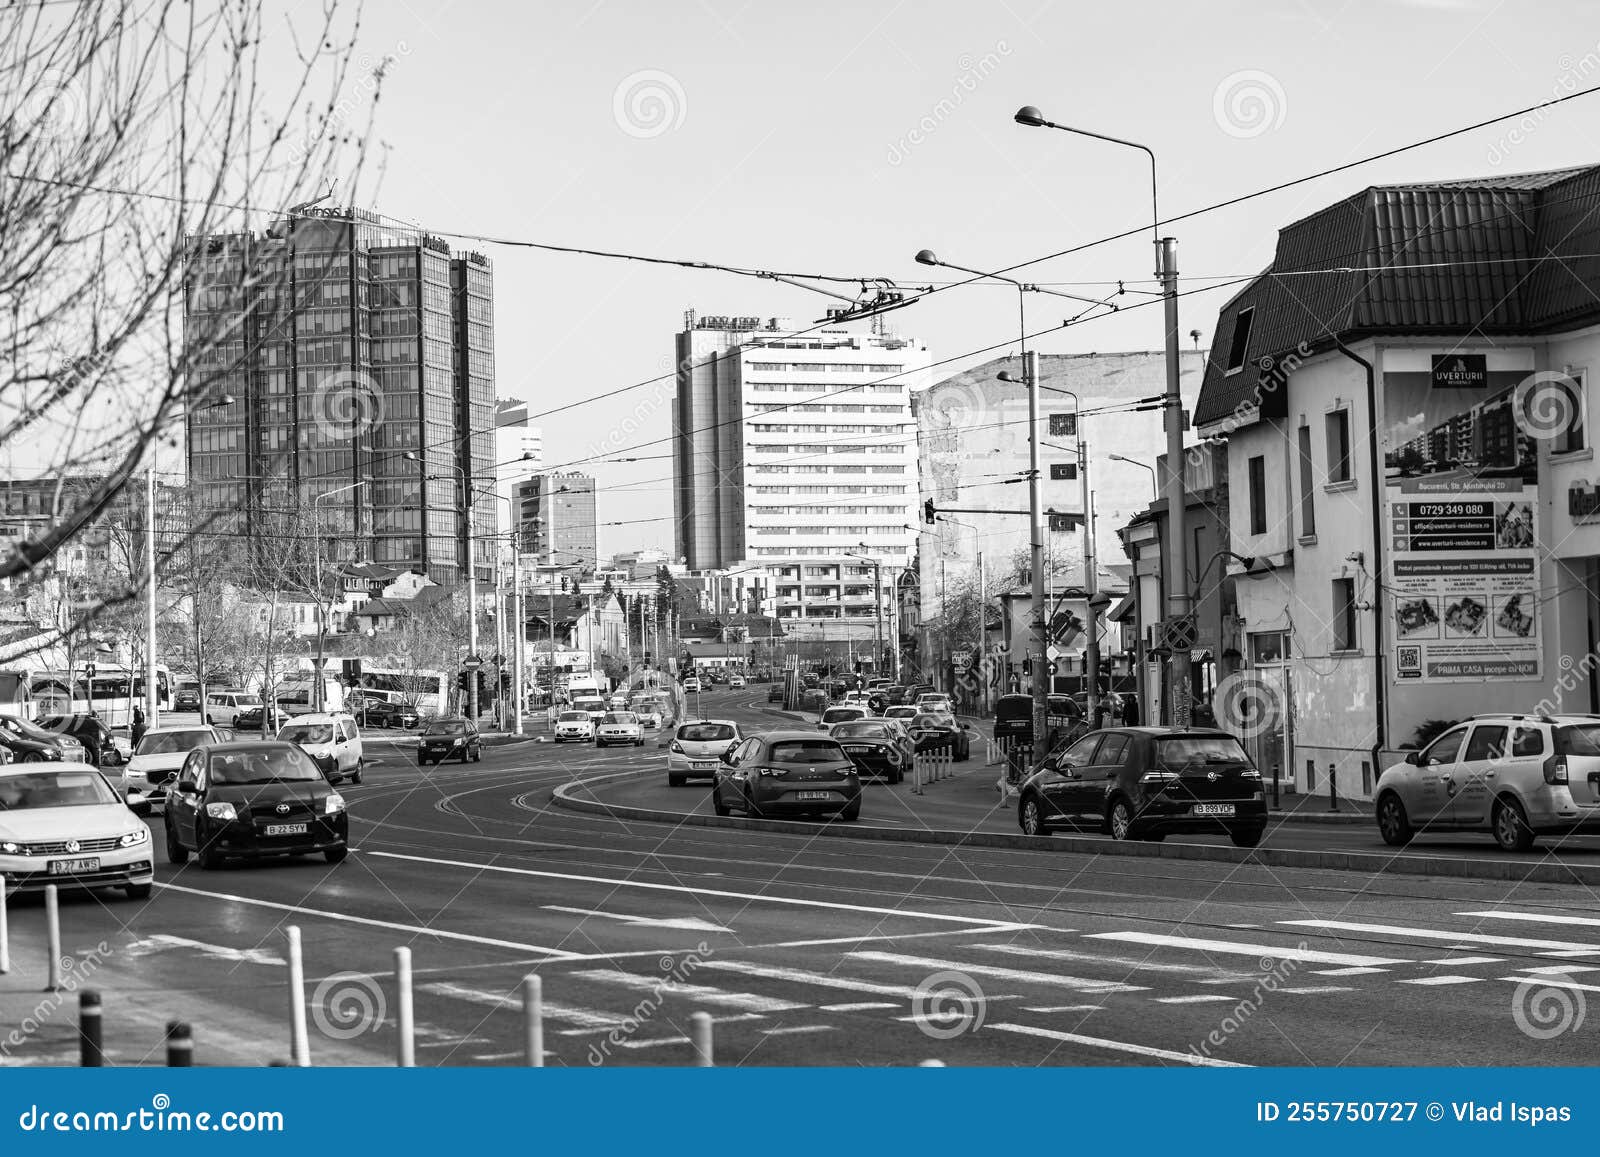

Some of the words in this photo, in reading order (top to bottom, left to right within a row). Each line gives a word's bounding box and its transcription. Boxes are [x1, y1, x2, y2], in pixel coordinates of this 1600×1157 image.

[1436, 372, 1483, 380] UVERTURII
[1420, 505, 1444, 515] 0729
[1445, 505, 1464, 515] 349
[1465, 504, 1484, 514] 080
[1437, 665, 1461, 674] PRIMA
[1462, 664, 1483, 674] CASA
[1198, 805, 1204, 813] B
[269, 825, 275, 834] B
[290, 823, 305, 833] SYY
[56, 861, 61, 872] B
[79, 859, 97, 870] AWS
